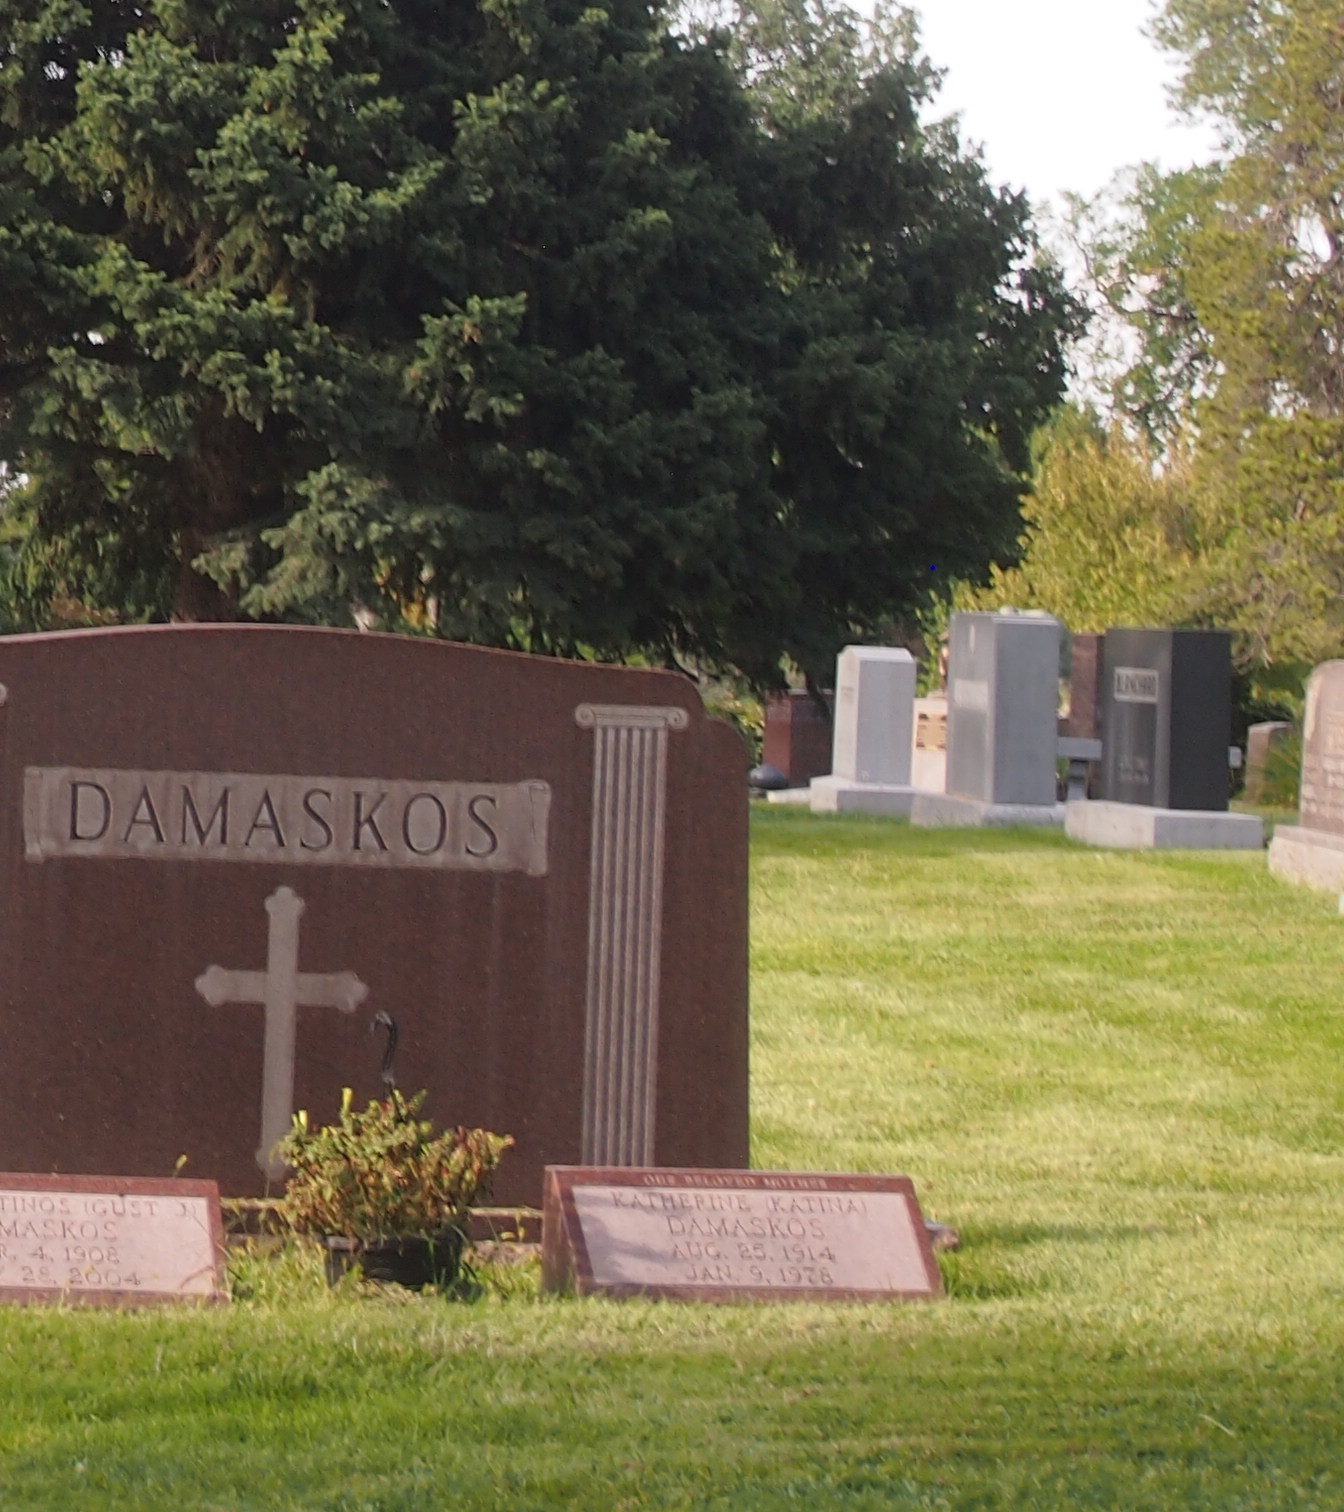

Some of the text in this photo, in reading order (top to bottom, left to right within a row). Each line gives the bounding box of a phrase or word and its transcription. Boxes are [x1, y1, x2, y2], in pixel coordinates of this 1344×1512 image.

[68, 779, 500, 859] DAMASKOS
[643, 1174, 829, 1190] OUR BELOVED MOTHER
[611, 1190, 867, 1214] KATHERINE (KATINA)
[666, 1216, 826, 1238] DAMASKOS
[30, 1245, 55, 1263] 4,
[64, 1246, 120, 1265] 1908
[673, 1242, 729, 1261] AUG.
[782, 1245, 836, 1264] 1914
[69, 1267, 142, 1286] 2004
[685, 1264, 834, 1285] JAN. 9, 1978
